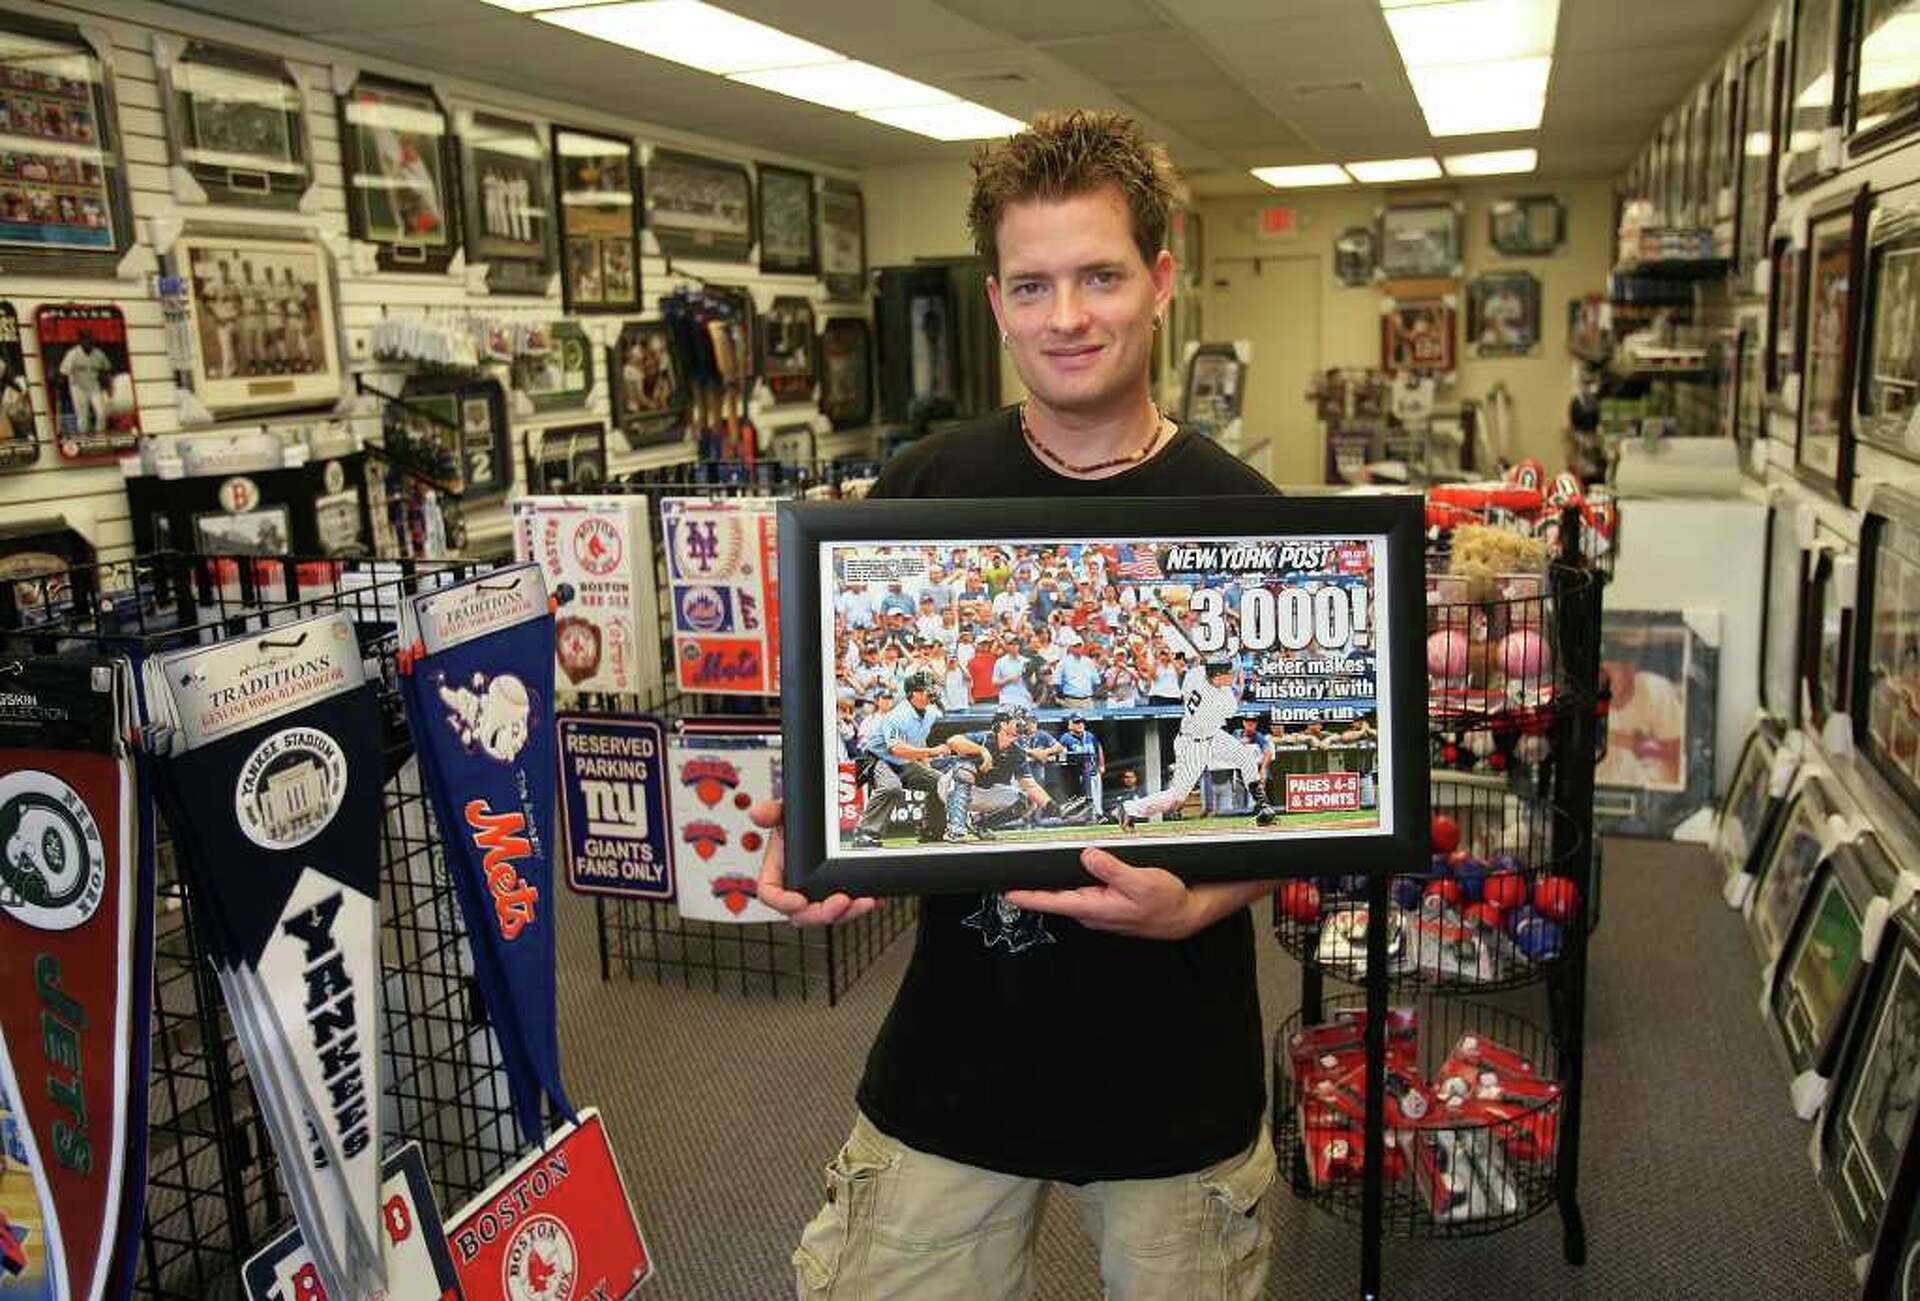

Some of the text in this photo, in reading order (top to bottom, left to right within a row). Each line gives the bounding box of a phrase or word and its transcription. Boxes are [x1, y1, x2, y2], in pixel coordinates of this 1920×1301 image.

[472, 453, 492, 482] 2
[1166, 546, 1217, 570] NEW
[1217, 547, 1274, 569] YORK
[1277, 546, 1334, 569] POST
[579, 582, 630, 593] BOSTON
[445, 590, 523, 624] TRADITIONS
[1189, 585, 1371, 657] 3,000!
[1257, 657, 1366, 676] Jeter makes
[208, 653, 331, 708] TRADITIONS
[1332, 680, 1375, 698] with
[1270, 706, 1355, 721] home run
[567, 734, 654, 758] RESERVED
[240, 740, 280, 797] YANKEE
[283, 732, 336, 761] STADIUM
[575, 757, 648, 780] PARKING
[1289, 778, 1331, 793] PAGES
[1304, 793, 1356, 808] SPORTS
[584, 839, 654, 864] GIANTS
[463, 799, 539, 941] Mets
[575, 857, 665, 882] FANS ONLY
[77, 858, 102, 916] YORK
[283, 890, 371, 1160] YANKEES
[33, 952, 92, 1174] JETS
[455, 1150, 571, 1265] BOSTON
[509, 1222, 561, 1278] BOSTON
